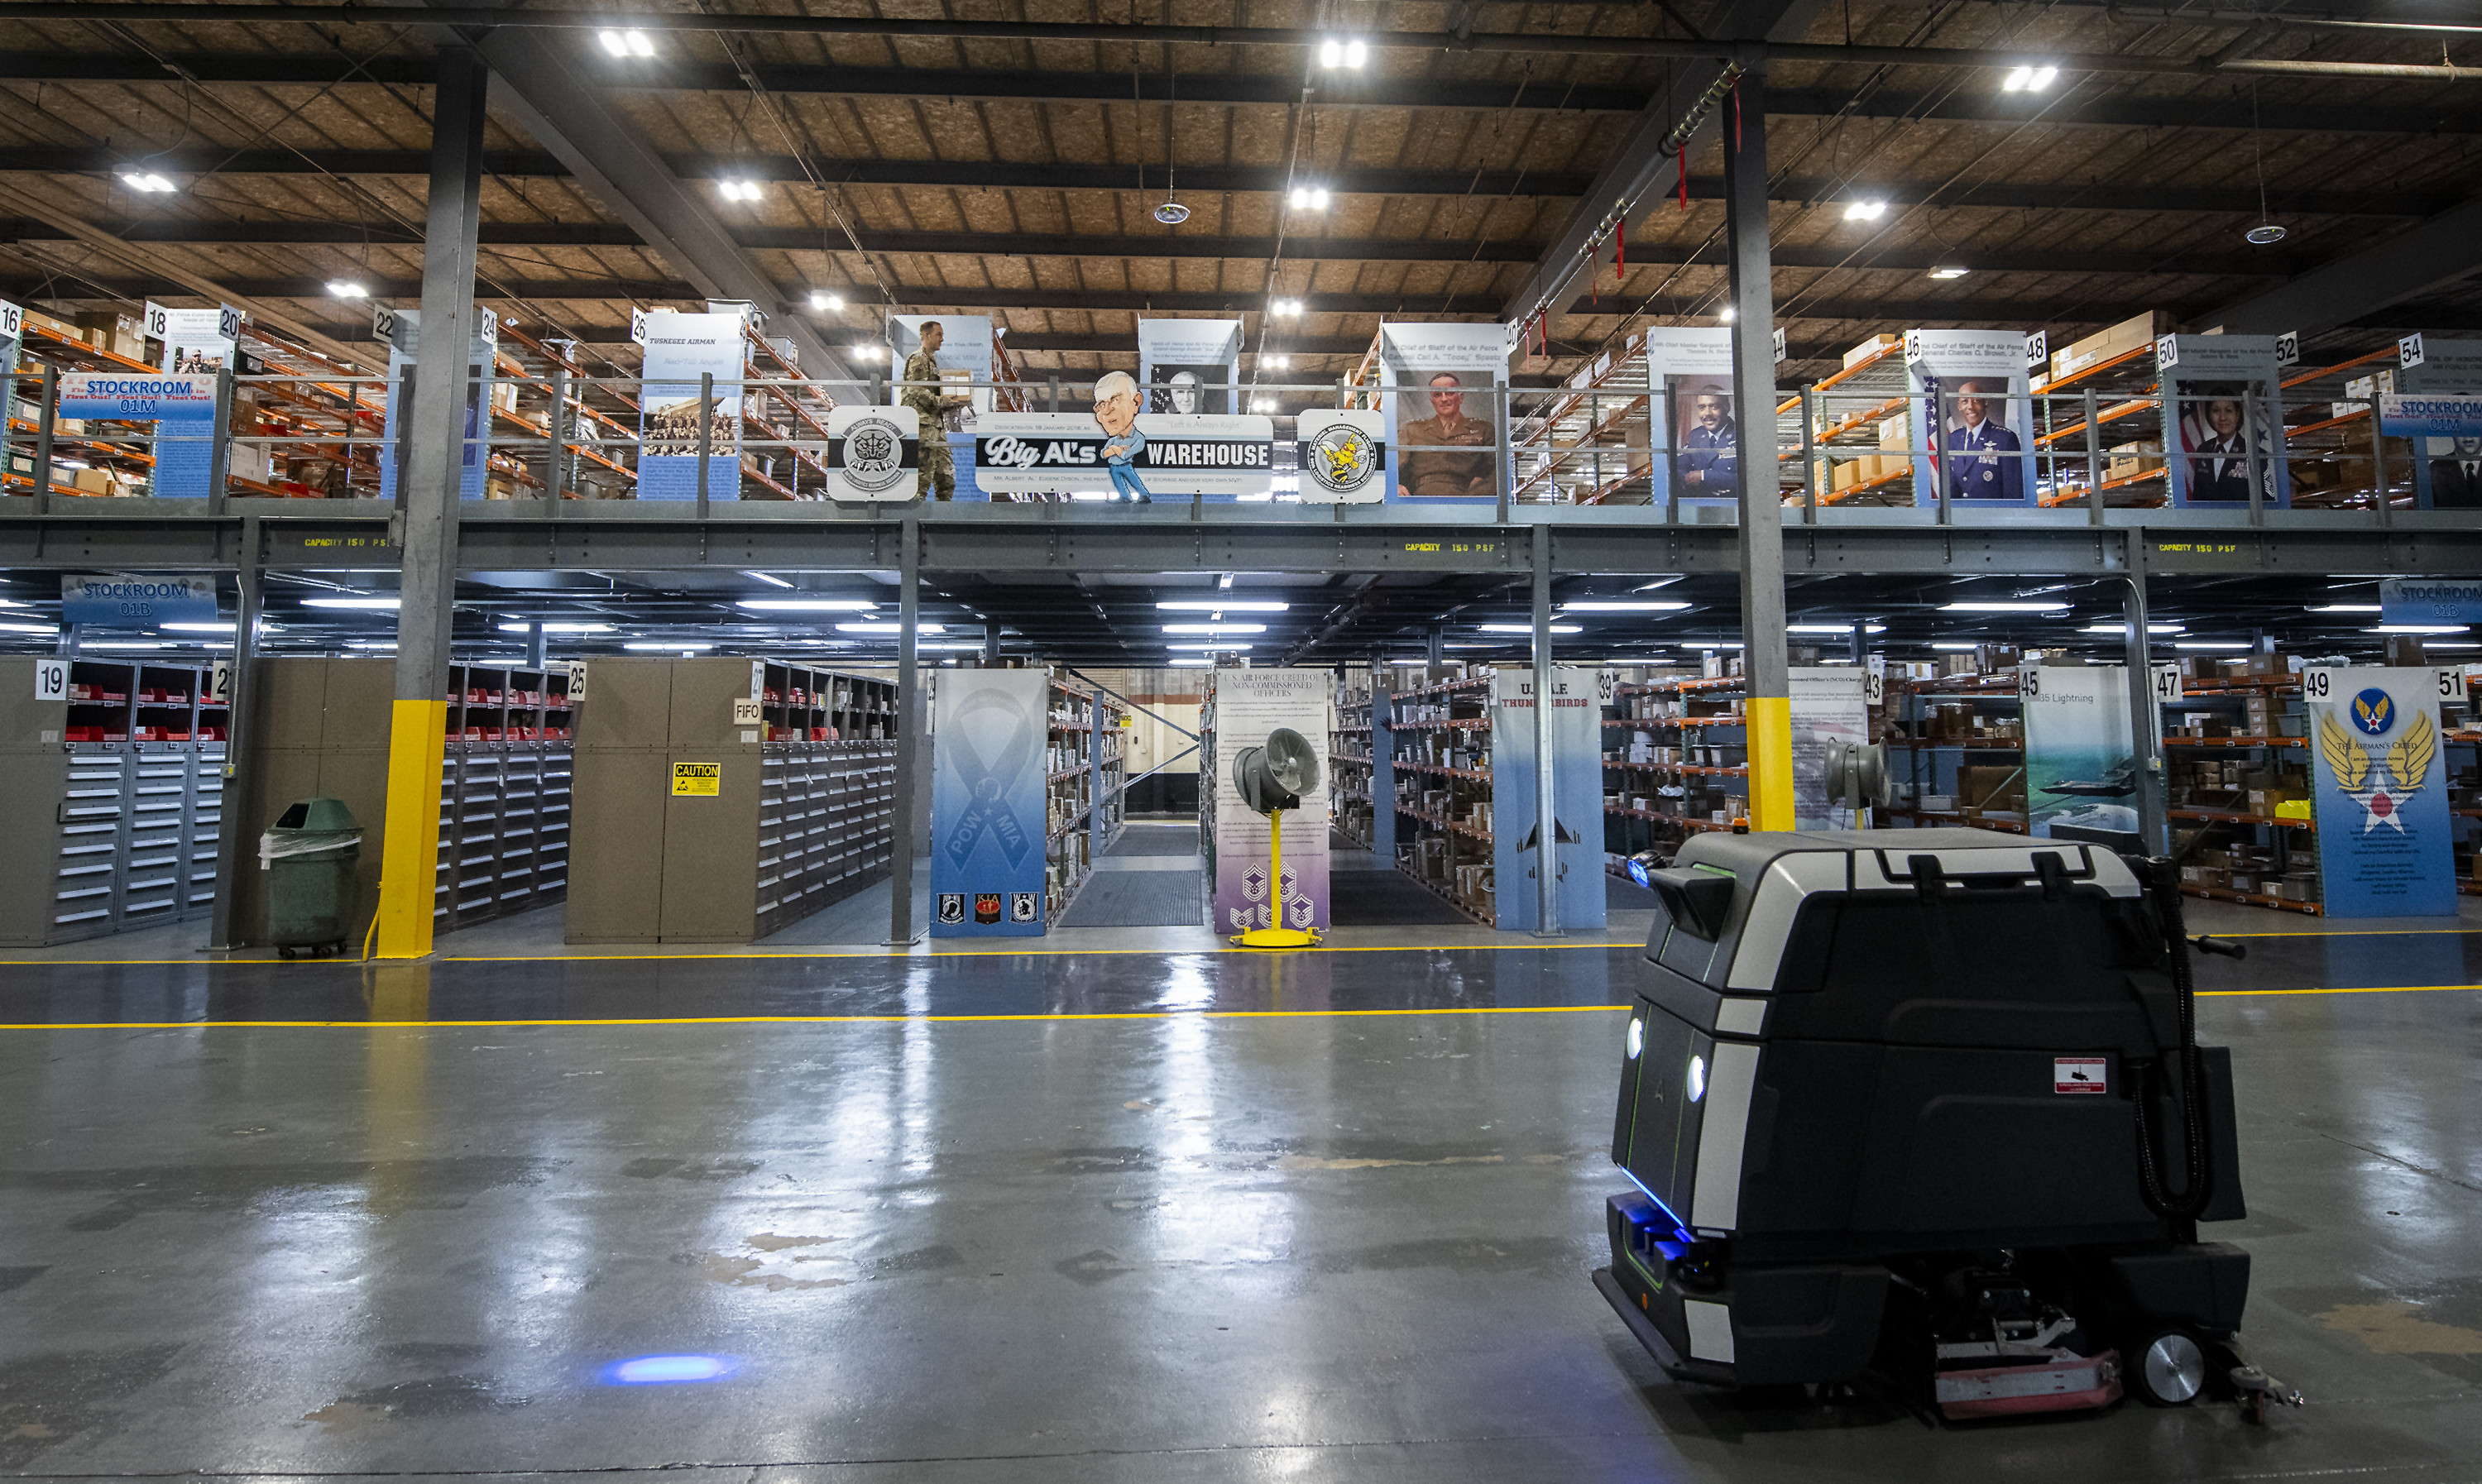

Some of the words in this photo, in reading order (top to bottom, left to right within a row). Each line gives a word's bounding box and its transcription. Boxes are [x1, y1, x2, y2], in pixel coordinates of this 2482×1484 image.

[2, 307, 18, 333] 16
[150, 309, 165, 335] 18
[221, 309, 238, 337] 20
[376, 311, 394, 338] 22
[483, 314, 496, 340] 24
[634, 314, 646, 341] 26
[1906, 335, 1919, 360] 46
[2027, 337, 2044, 361] 48
[2159, 339, 2175, 365] 50
[2276, 337, 2296, 361] 52
[2402, 337, 2421, 363] 54
[87, 381, 191, 395] STOCKROOM
[120, 399, 156, 414] 01M
[850, 419, 874, 431] ALWAYS
[876, 419, 897, 430] READY
[1327, 424, 1363, 435] MANAGEMENT
[2430, 419, 2460, 431] 01M
[985, 434, 1042, 472] Big
[1147, 443, 1268, 466] WAREHOUSE
[1405, 543, 1440, 552] CAPACITY
[1452, 543, 1469, 552] 150
[2159, 543, 2192, 553] CAPACITY
[2197, 543, 2212, 553] 150
[84, 582, 189, 598] STOCKROOM
[120, 601, 152, 616] 01B
[2432, 603, 2460, 618] 01B
[41, 666, 63, 694] 19
[570, 667, 585, 695] 25
[753, 668, 763, 695] 27
[1241, 673, 1253, 682] AIR
[1255, 673, 1280, 682] FORCE
[1282, 673, 1308, 682] CREED
[1309, 673, 1319, 682] OF
[1599, 674, 1612, 700] 39
[1865, 673, 1880, 699] 43
[2021, 671, 2039, 697] 45
[2158, 672, 2178, 697] 47
[2306, 672, 2330, 697] 49
[2439, 671, 2462, 697] 51
[2052, 693, 2094, 704] Lightning
[736, 705, 759, 718] FIFO
[2336, 741, 2353, 750] THE
[2355, 741, 2391, 750] AIRMAN'S
[2391, 741, 2418, 750] CREED
[676, 765, 718, 776] CAUTION
[951, 810, 983, 854] POW
[996, 814, 1021, 849] MIA
[978, 894, 999, 902] KIA
